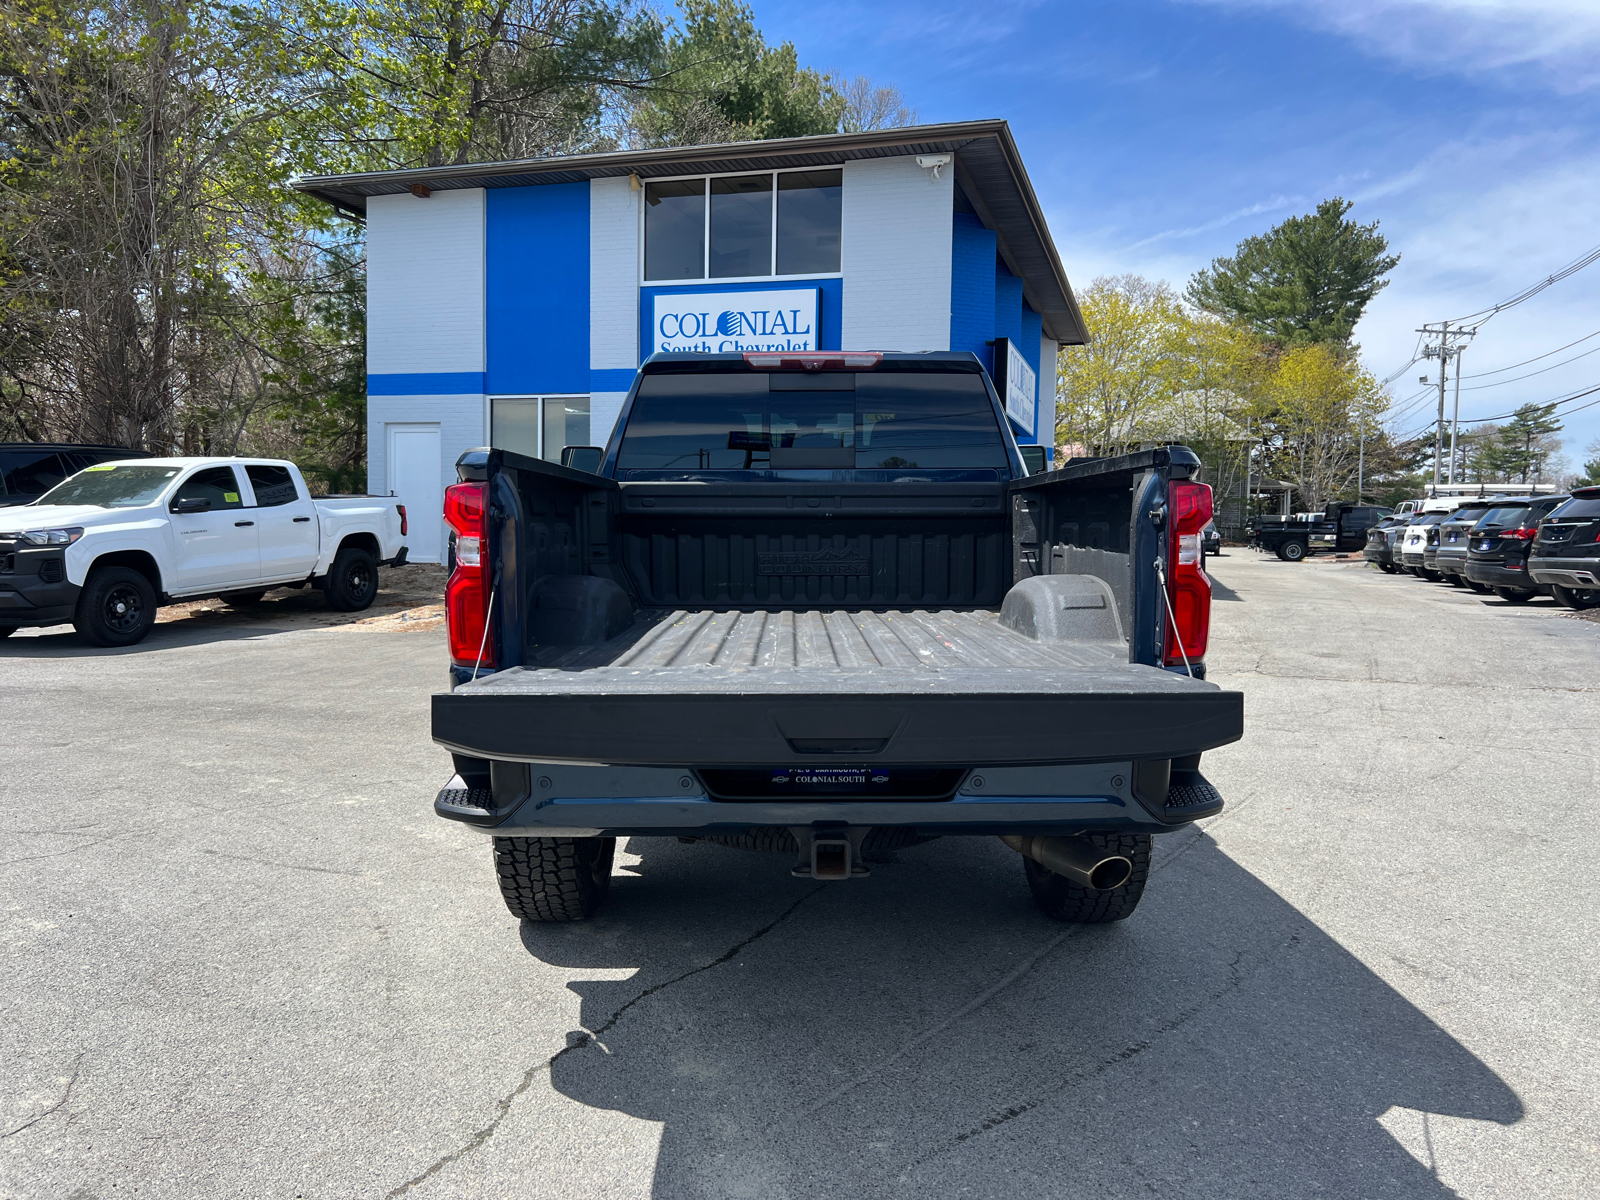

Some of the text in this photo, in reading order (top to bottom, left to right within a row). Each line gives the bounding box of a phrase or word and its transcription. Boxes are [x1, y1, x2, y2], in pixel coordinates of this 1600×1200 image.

[659, 309, 810, 338] COLONIAL
[759, 554, 812, 564] HIGH
[760, 564, 868, 574] COUNTRY
